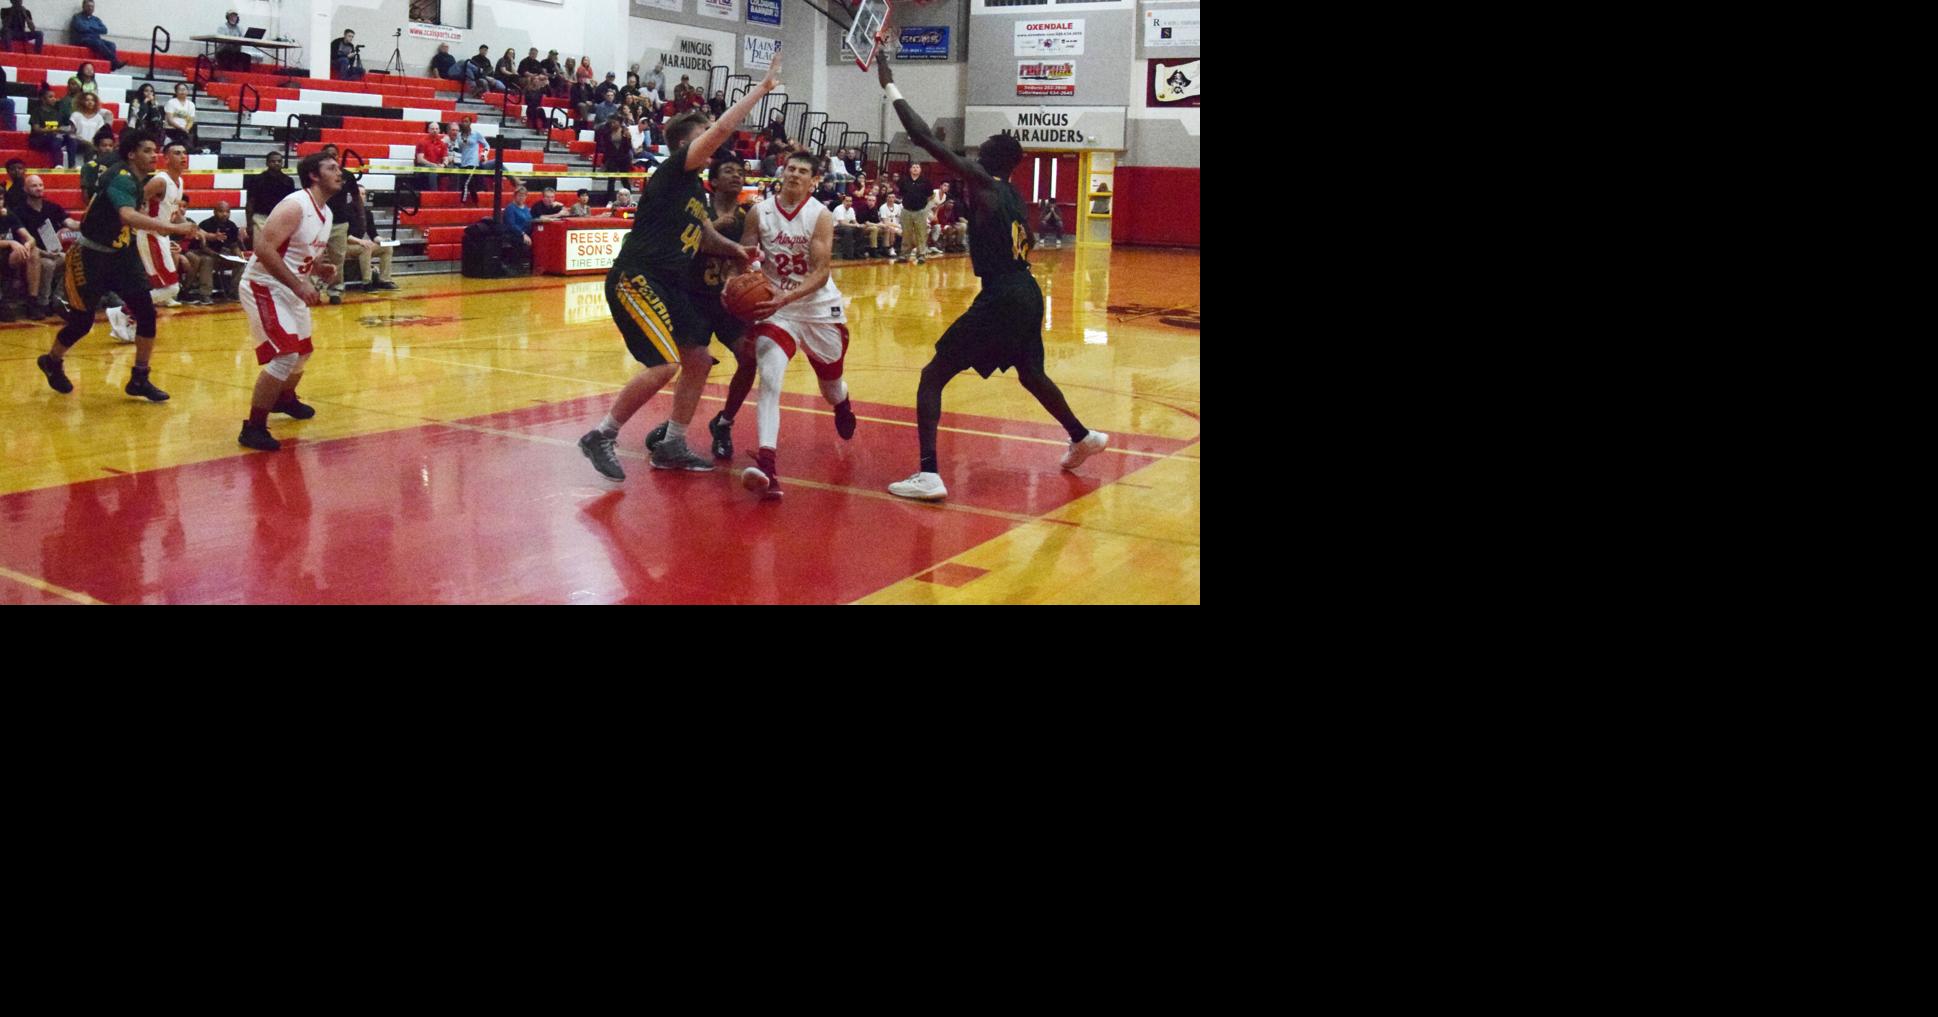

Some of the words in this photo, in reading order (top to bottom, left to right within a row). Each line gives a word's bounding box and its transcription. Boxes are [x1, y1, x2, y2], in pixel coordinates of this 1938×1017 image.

[680, 40, 712, 56] MINGUS
[660, 53, 712, 72] MARAUDERS
[1017, 113, 1068, 126] MINGUS
[1001, 128, 1084, 143] MARAUDERS
[570, 232, 608, 244] REESE
[613, 232, 620, 242] &
[577, 244, 613, 256] SON'S
[571, 259, 592, 267] TIRE
[595, 258, 614, 266] TEA
[775, 253, 808, 276] 25
